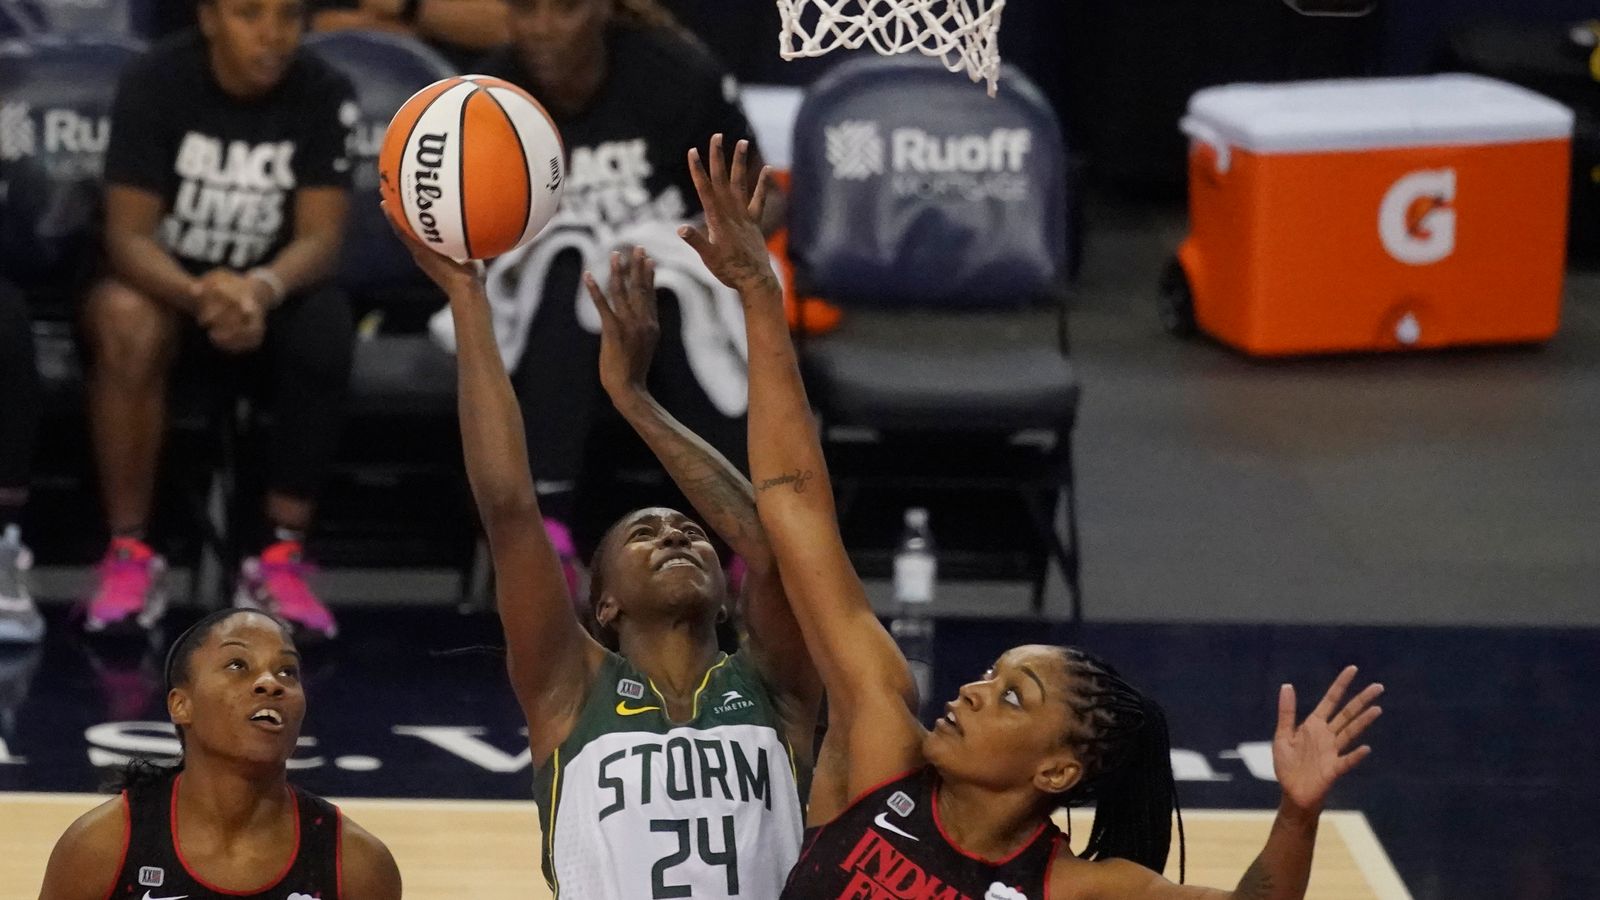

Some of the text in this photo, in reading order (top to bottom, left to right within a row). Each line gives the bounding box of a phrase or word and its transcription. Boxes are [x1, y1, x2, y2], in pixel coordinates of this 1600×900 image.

[175, 131, 296, 190] BLACK
[415, 132, 448, 244] Wilson
[892, 127, 1032, 172] Ruoff
[1377, 167, 1457, 265] G
[713, 700, 755, 715] SYMETRA
[598, 736, 772, 822] STORM
[650, 815, 740, 900] 24
